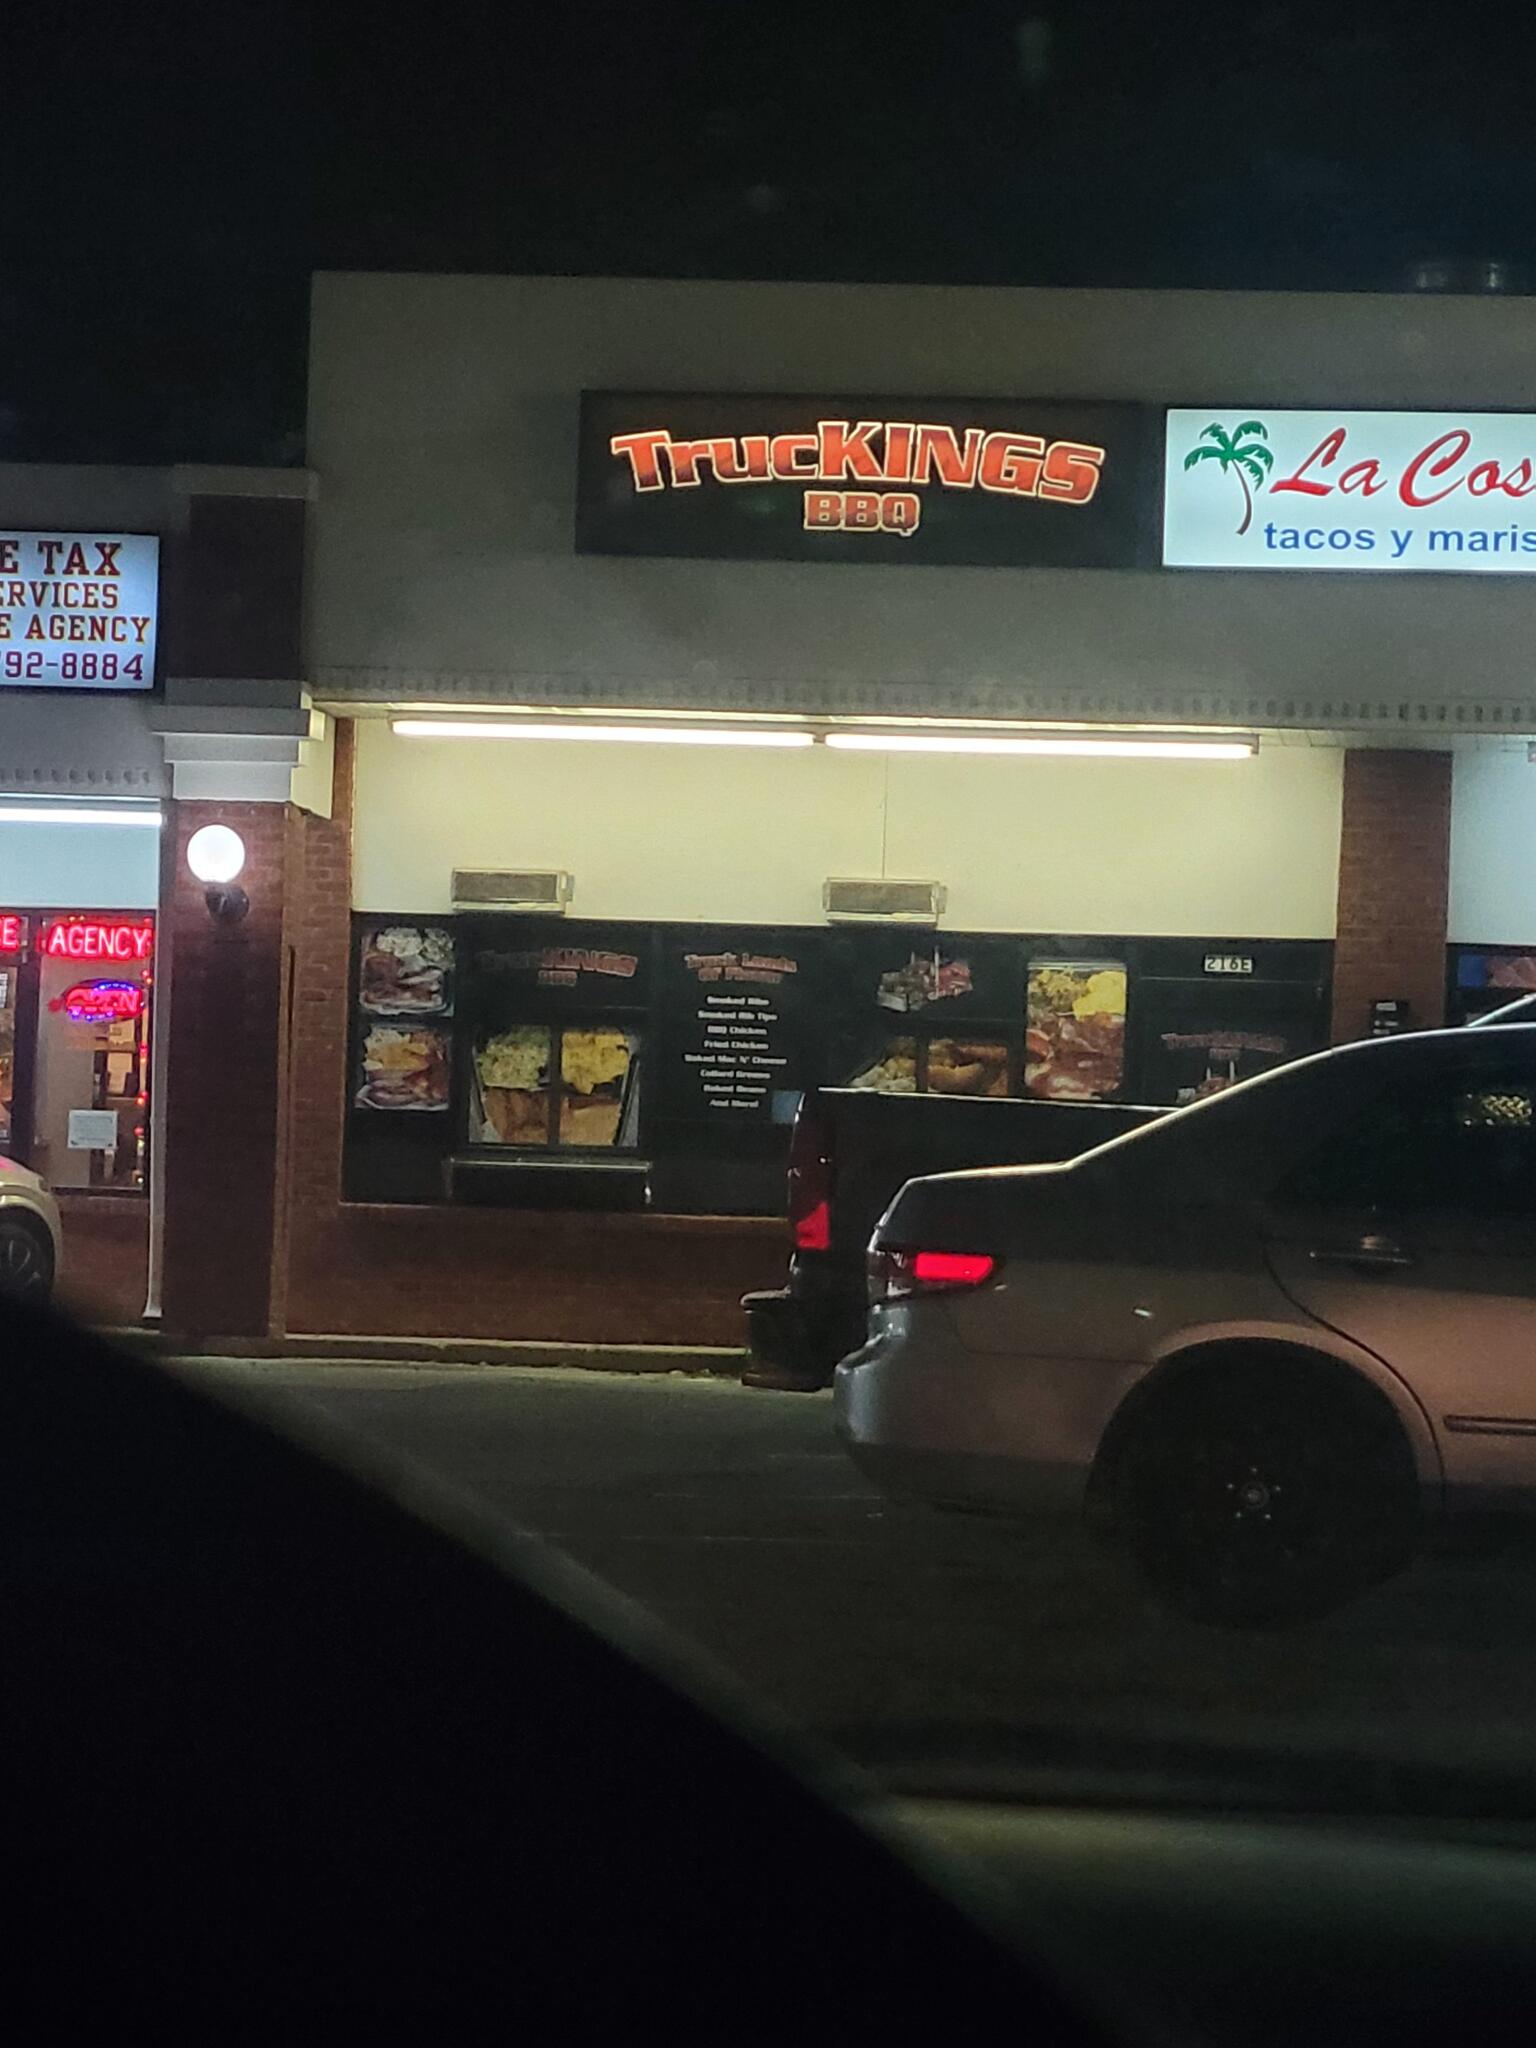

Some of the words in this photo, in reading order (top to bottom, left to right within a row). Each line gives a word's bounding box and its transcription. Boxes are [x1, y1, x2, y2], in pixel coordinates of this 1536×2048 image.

[611, 421, 1105, 504] TrucKINGS
[1269, 428, 1388, 496] La
[1399, 429, 1536, 507] Cos
[804, 491, 919, 536] BBQ
[1264, 523, 1376, 550] tacos
[1391, 529, 1414, 558] y
[1429, 524, 1536, 552] maris
[38, 540, 122, 576] TAX
[0, 581, 118, 608] RVICES
[25, 614, 150, 643] AGENCY
[0, 650, 143, 680] 92-8884
[50, 925, 148, 957] AGENCY
[1206, 956, 1250, 971] 216E
